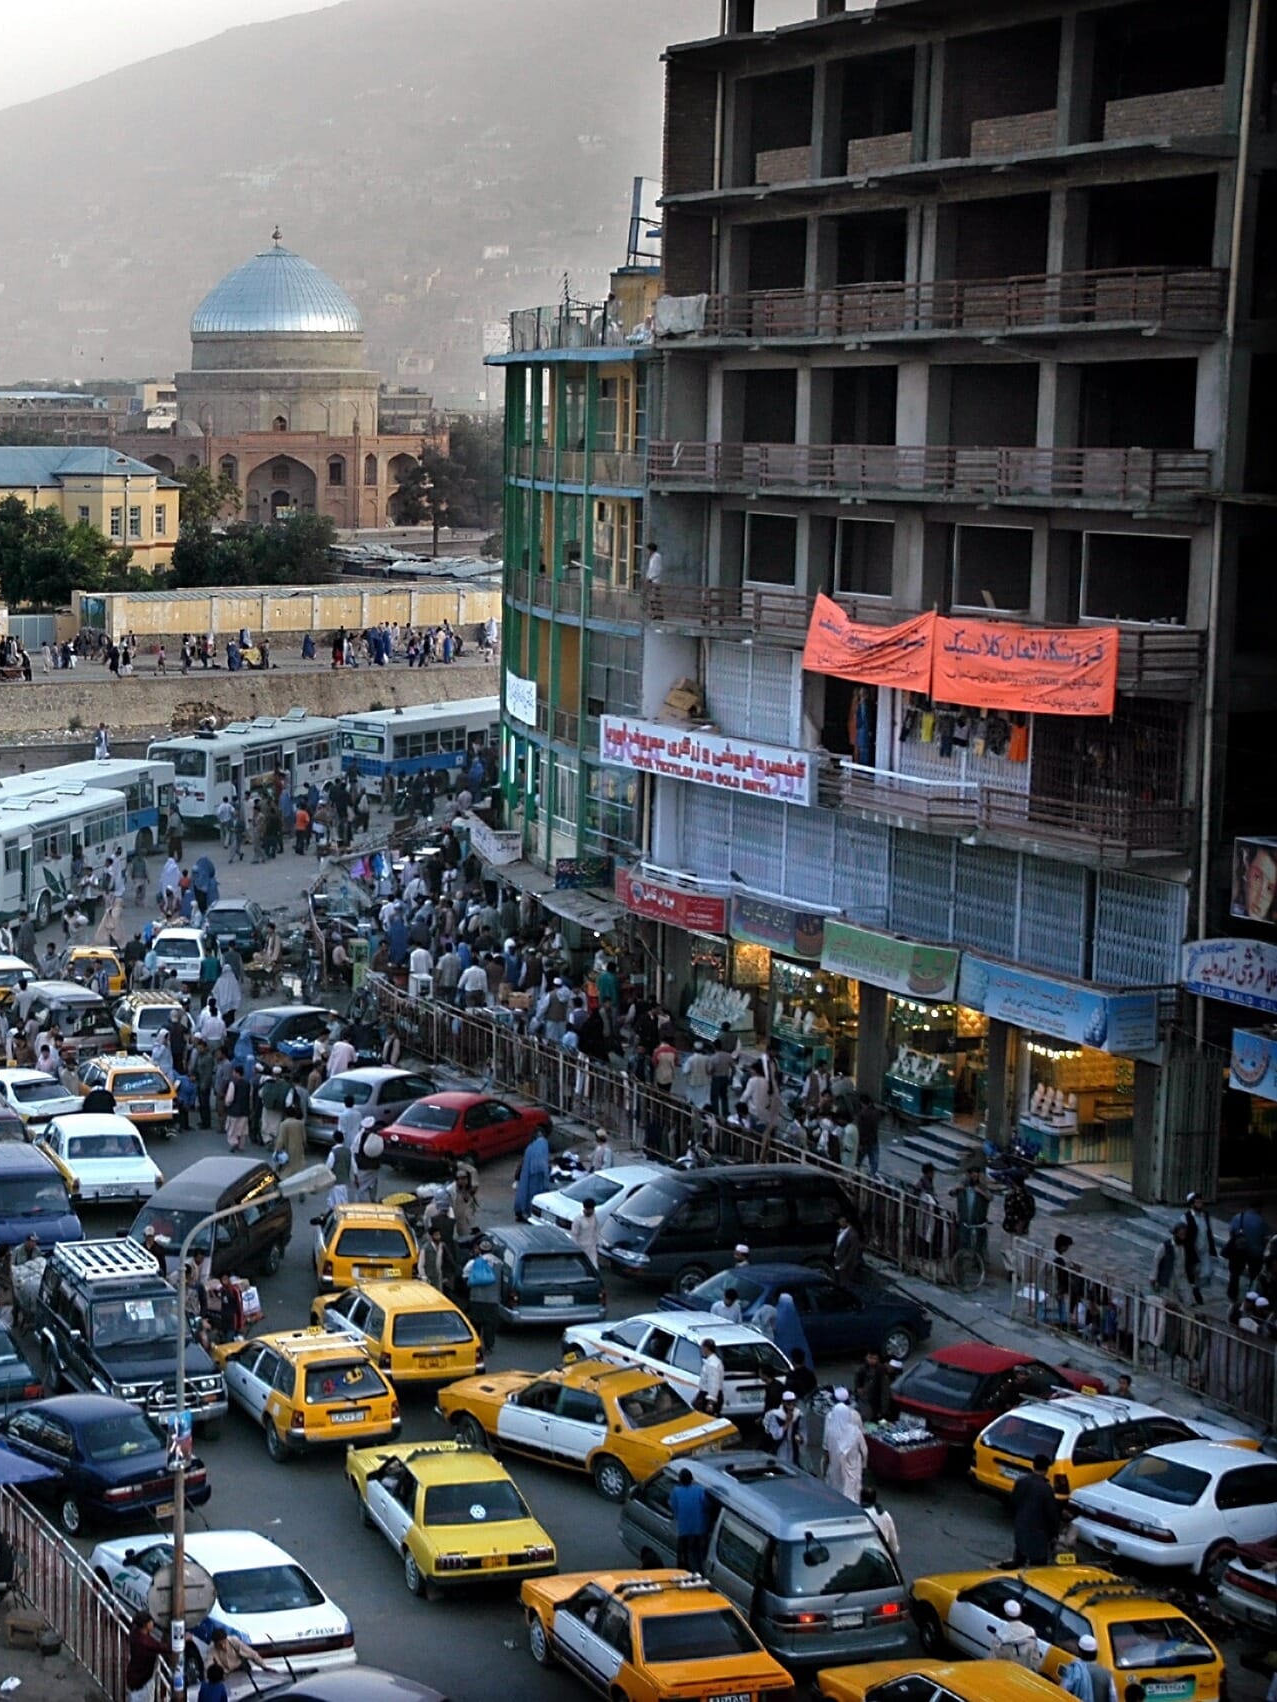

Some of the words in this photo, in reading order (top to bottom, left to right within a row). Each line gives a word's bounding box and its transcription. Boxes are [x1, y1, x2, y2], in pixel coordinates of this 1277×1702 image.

[943, 629, 1005, 661] کلاسیک
[1001, 632, 1043, 661] افغان
[667, 736, 700, 762] زرگری
[702, 747, 710, 764] و
[712, 742, 756, 773] فروشی
[655, 759, 694, 779] TEXTILES
[696, 768, 714, 783] AND
[715, 773, 741, 789] GOLD
[742, 778, 772, 795] SMITH
